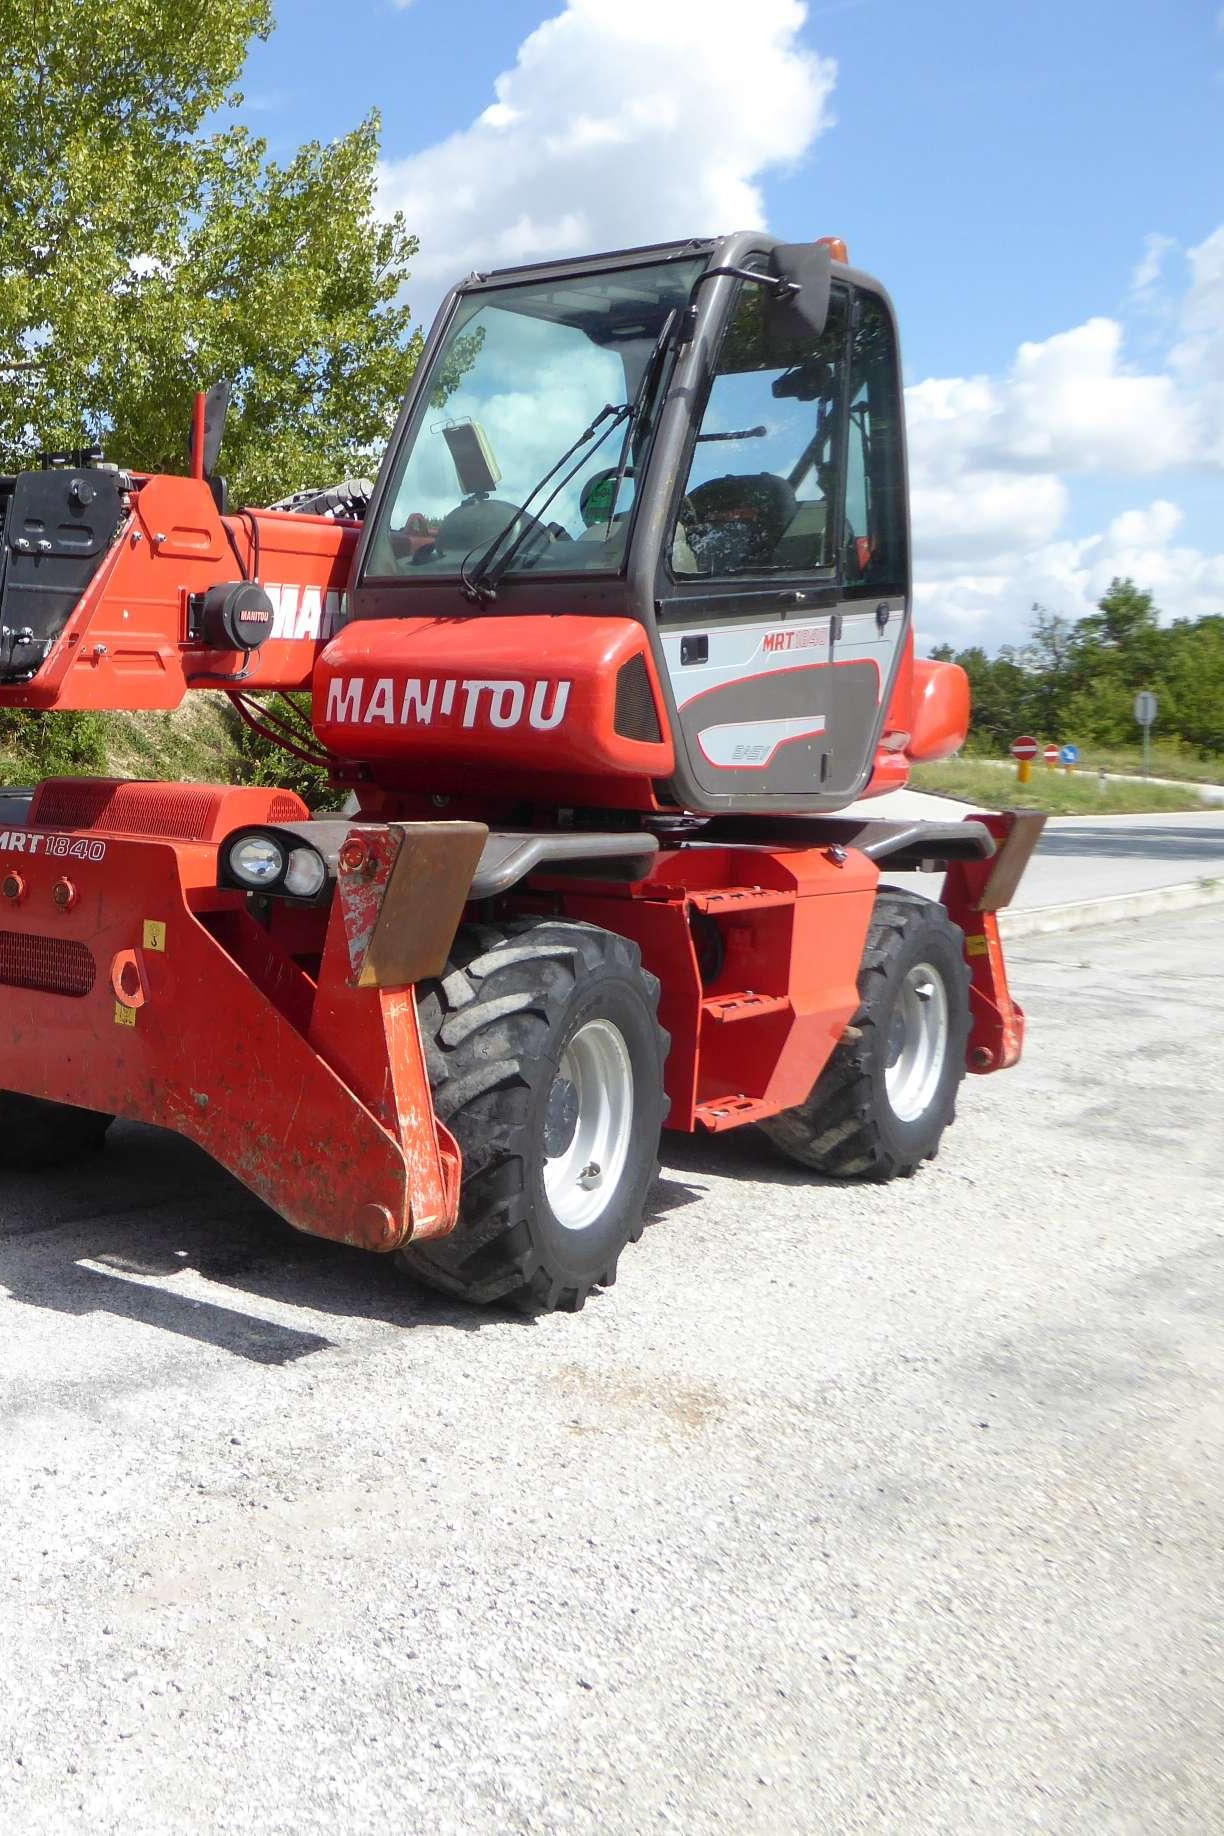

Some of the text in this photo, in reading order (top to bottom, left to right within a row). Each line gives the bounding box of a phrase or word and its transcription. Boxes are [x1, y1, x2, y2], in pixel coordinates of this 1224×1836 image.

[240, 610, 269, 622] MANITOU
[762, 632, 794, 652] MRT
[325, 677, 571, 729] MANITOU
[44, 835, 106, 861] 1840
